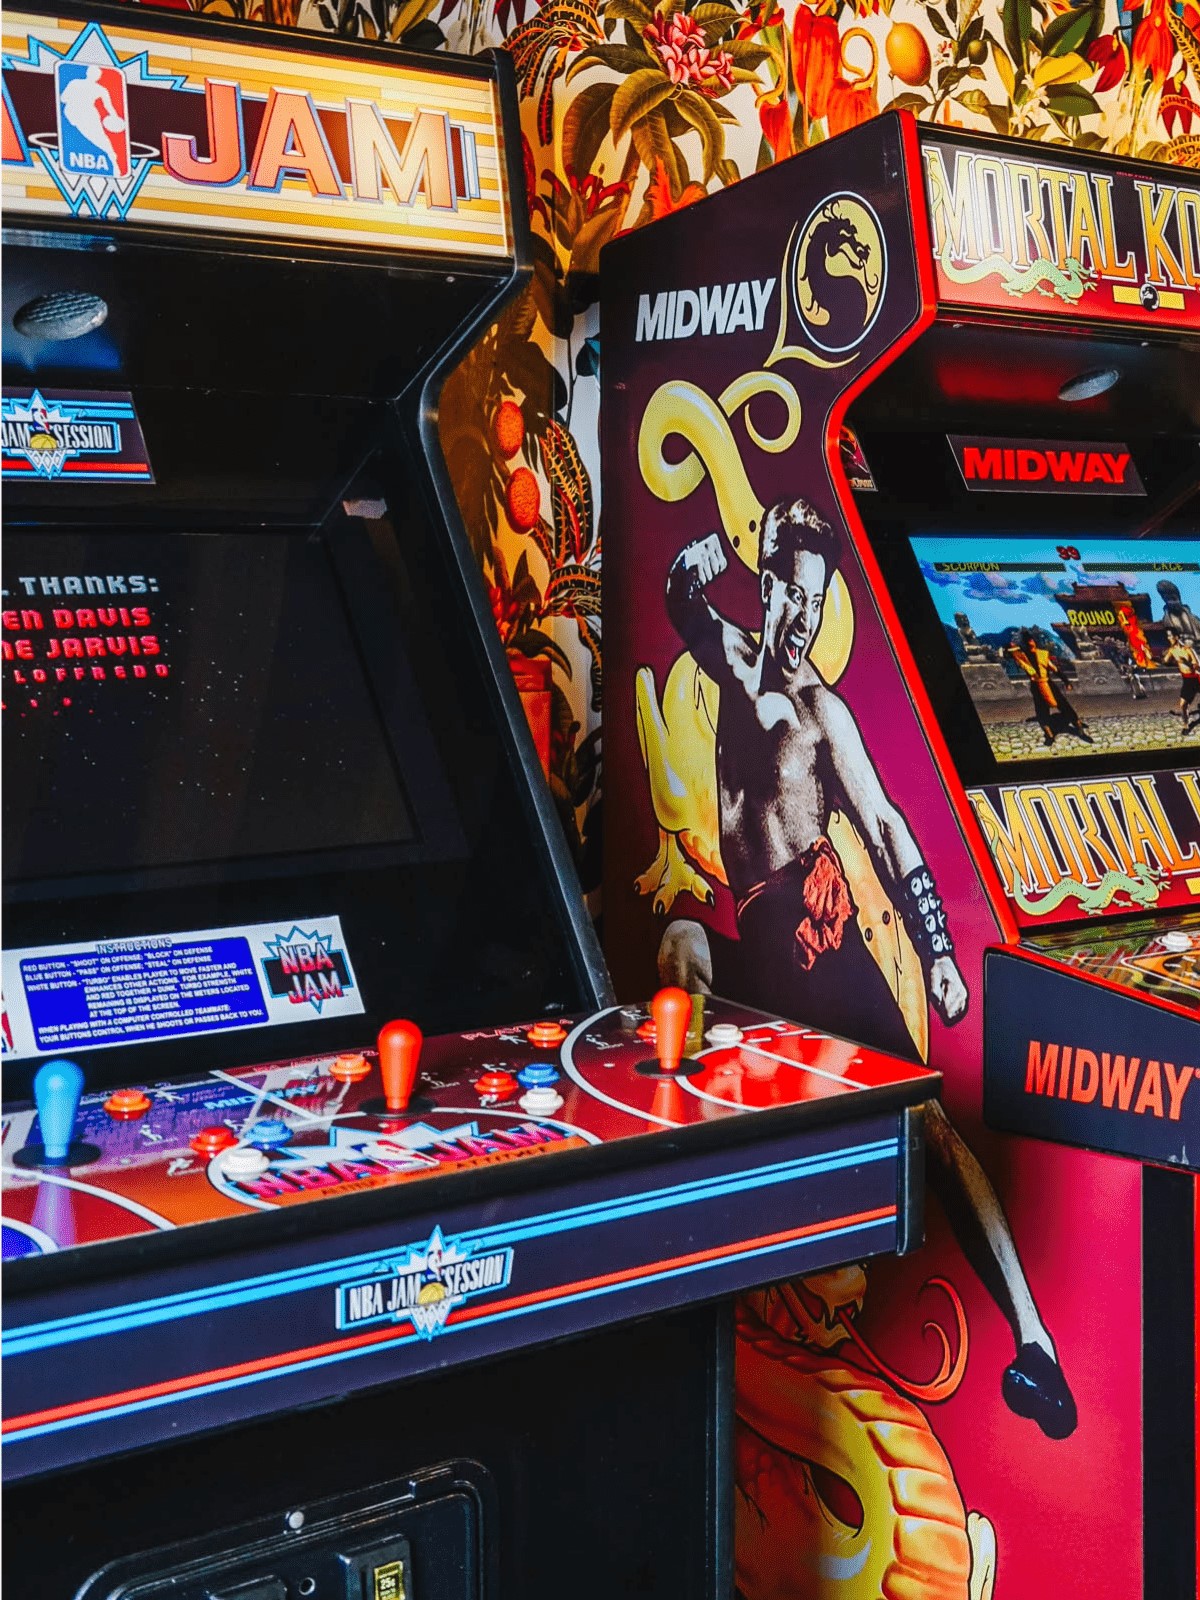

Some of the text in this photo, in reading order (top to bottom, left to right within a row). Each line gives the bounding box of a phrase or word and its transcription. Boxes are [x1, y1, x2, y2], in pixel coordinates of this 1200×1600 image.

[162, 77, 457, 213] JAM
[68, 152, 109, 174] NBA
[921, 147, 1137, 281] MORTAL
[635, 278, 776, 343] MIDWAY
[2, 422, 113, 449] JAM SESSION
[964, 447, 1131, 484] MIDWAY
[1056, 545, 1081, 561] 99
[943, 562, 1000, 572] SCORPION
[18, 574, 160, 596] THANKS:
[52, 606, 152, 629] DAVIS
[1067, 608, 1130, 628] ROUND 1
[46, 634, 161, 660] JARVIS
[969, 775, 1200, 898] MORTAL
[38, 962, 66, 970] BUTTON
[184, 946, 213, 955] DEFENSE
[95, 937, 173, 954] INSTRUCTIONS
[277, 942, 335, 974] NBA
[25, 973, 43, 981] BLUE
[44, 970, 72, 979] BUTTON
[182, 955, 212, 964] DEFENSE
[27, 983, 49, 992] WHITE
[49, 980, 77, 990] BUTTON
[111, 973, 142, 983] ENABLES
[143, 970, 168, 979] PLAYER
[179, 966, 197, 975] MOVE
[198, 964, 222, 972] FASTER
[84, 983, 123, 993] ENHANCES
[123, 980, 147, 990] OTHER
[231, 968, 253, 976] WHITE
[86, 993, 100, 1001] AND
[115, 987, 151, 998] TOGETHER
[180, 982, 202, 990] TURBO
[203, 978, 236, 988] STRENGTH
[87, 999, 125, 1010] REMAINING
[132, 993, 168, 1005] DISPLAYED
[194, 988, 219, 996] METERS
[221, 984, 250, 994] LOCATED
[287, 969, 345, 1005] JAM
[38, 1025, 59, 1034] WHEN
[60, 1022, 89, 1032] PLAYING
[89, 1020, 107, 1028] WITH
[113, 1014, 150, 1025] COMPUTER
[150, 1009, 194, 1020] CONTROLLED
[100, 1009, 113, 1017] THE
[113, 1007, 126, 1015] TOP
[138, 1004, 151, 1012] THE
[39, 1035, 59, 1043] YOUR
[60, 1030, 92, 1041] BUTTONS
[92, 1027, 125, 1037] CONTROL
[125, 1022, 145, 1033] WHEN
[146, 1022, 155, 1030] HE
[156, 1019, 183, 1029] SHOOTS
[184, 1017, 194, 1025] OR
[194, 1015, 219, 1023] PASSES
[220, 1012, 239, 1020] BACK
[239, 1010, 248, 1018] TO
[1023, 1039, 1198, 1121] MIDWAY
[237, 1160, 390, 1200] NBA
[433, 1121, 572, 1163] JAM
[350, 1254, 504, 1321] NBA JAM SESSION
